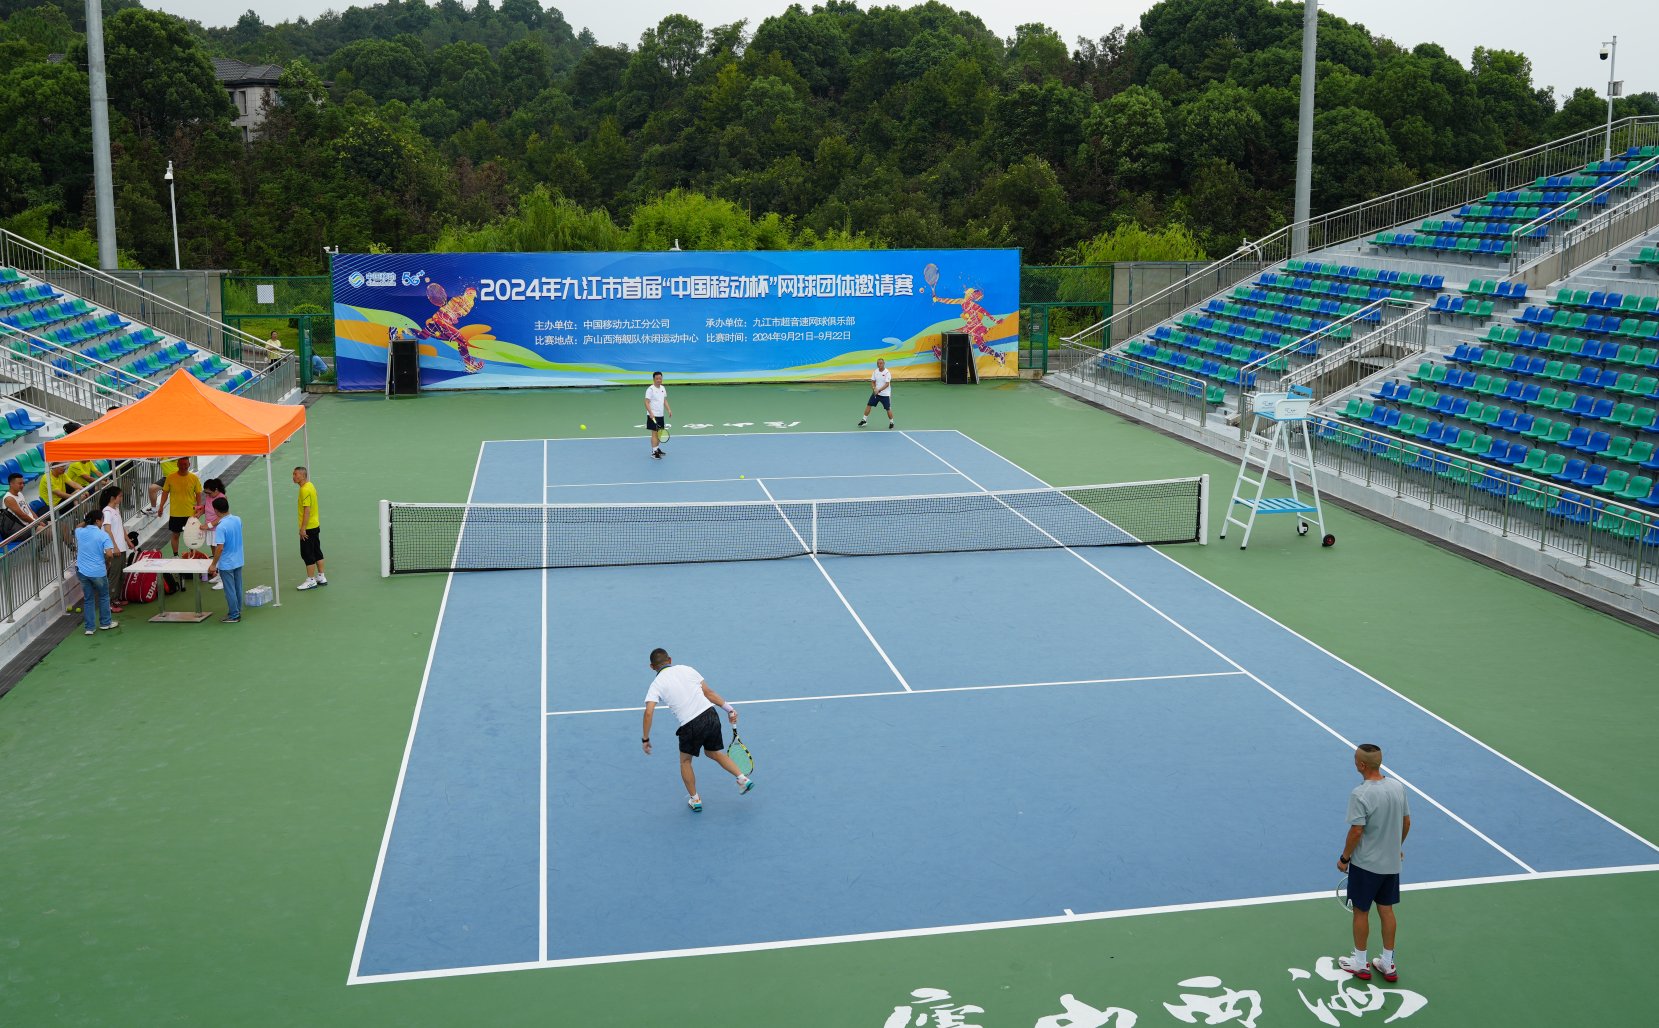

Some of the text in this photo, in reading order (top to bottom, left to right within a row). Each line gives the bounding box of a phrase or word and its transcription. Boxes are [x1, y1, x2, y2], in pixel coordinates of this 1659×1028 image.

[480, 274, 914, 300] 2024年九江市首届“中国移动杯”网球团体邀请赛
